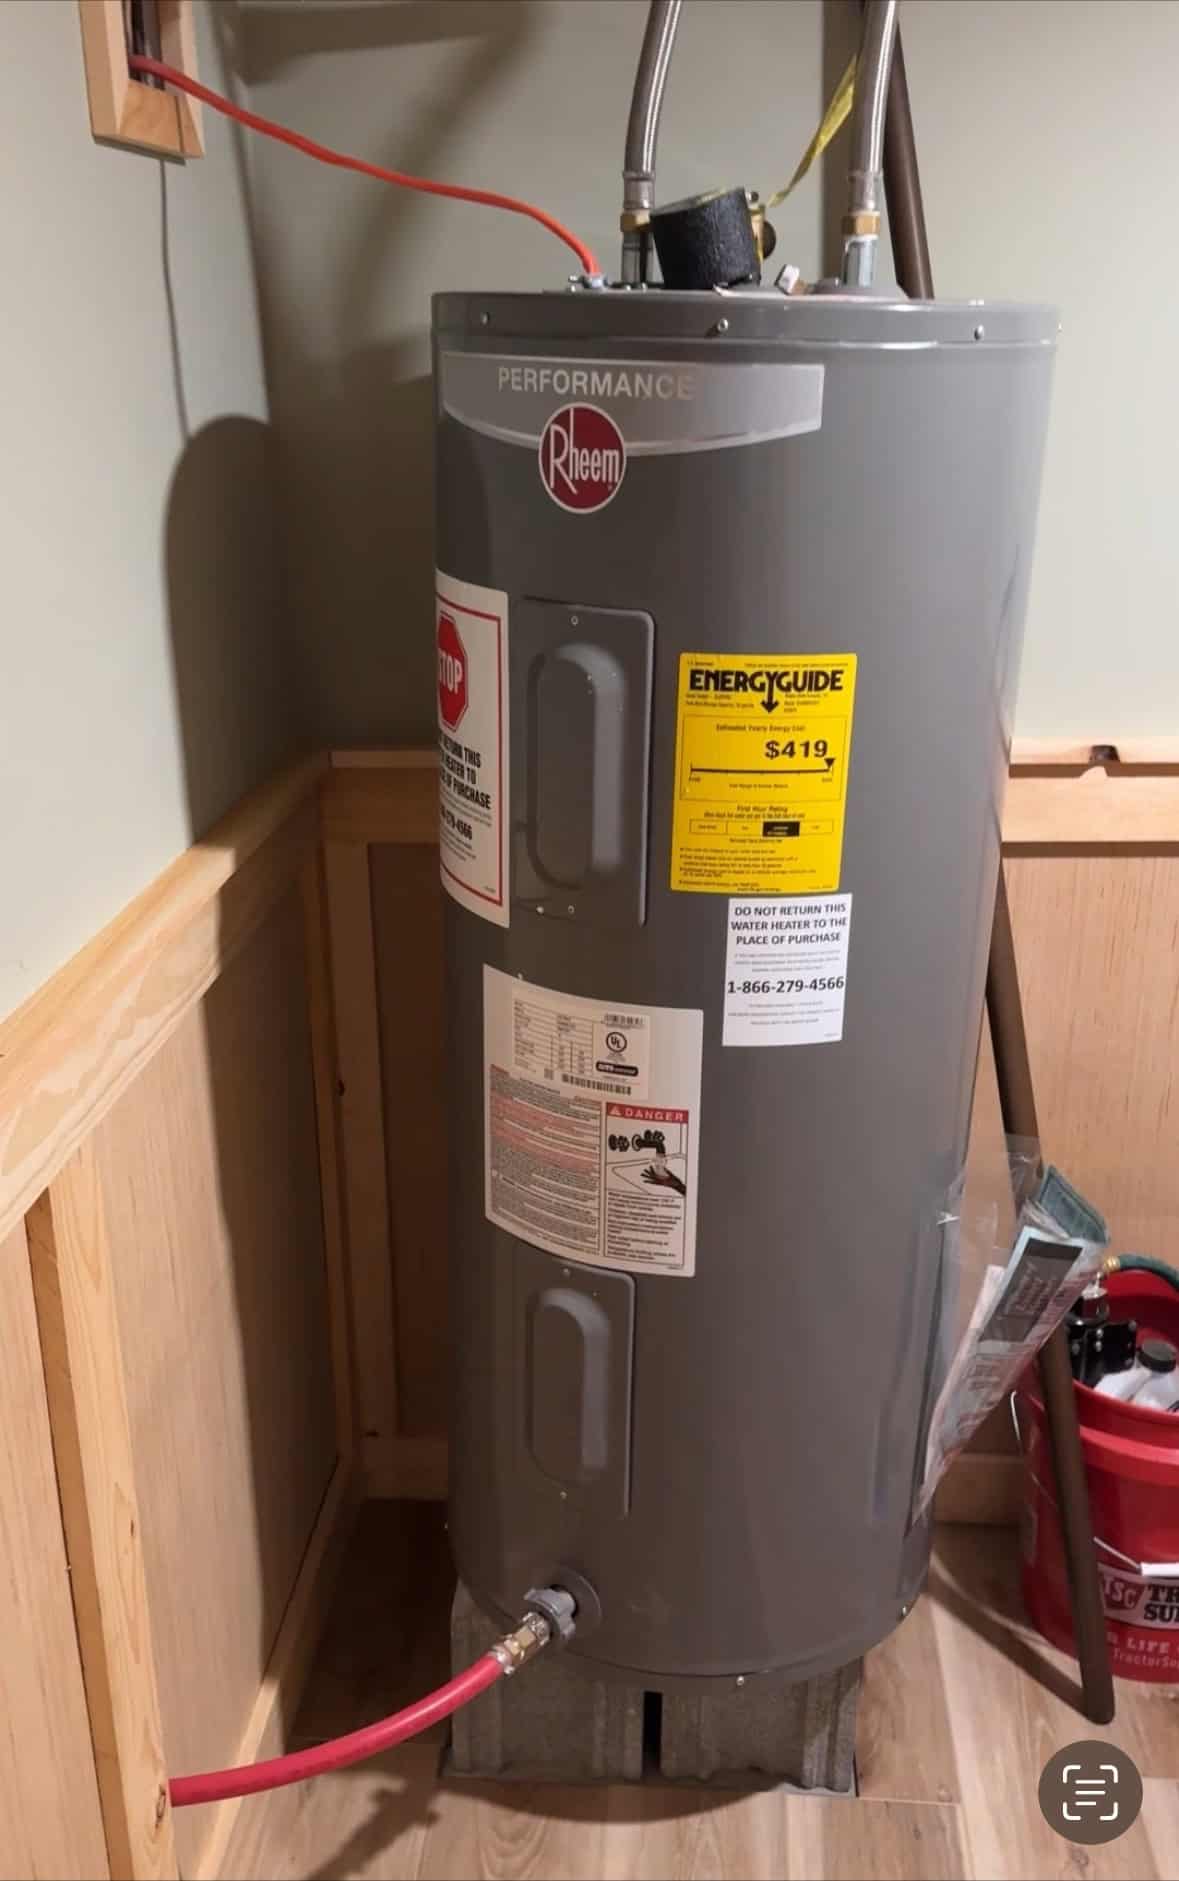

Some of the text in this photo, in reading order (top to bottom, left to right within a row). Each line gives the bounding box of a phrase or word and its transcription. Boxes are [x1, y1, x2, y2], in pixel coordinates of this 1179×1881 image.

[498, 366, 695, 400] PERFORMANCE
[549, 407, 620, 495] Rheem
[440, 649, 463, 694] TOP
[689, 669, 844, 698] ENERGYGUIDE
[464, 746, 481, 768] THIS
[765, 740, 828, 760] $419
[467, 767, 477, 785] TO
[453, 777, 491, 810] PURCHASE
[735, 903, 847, 917] DO NOT RETURN THIS
[730, 917, 848, 931] WATER HEATER TO THE
[736, 932, 841, 945] PLACE OF PURCHASE
[727, 976, 845, 995] 1-866-279-4566
[624, 1107, 684, 1122] DANGER
[1103, 1576, 1138, 1609] TSC
[1126, 1637, 1170, 1655] LIFE
